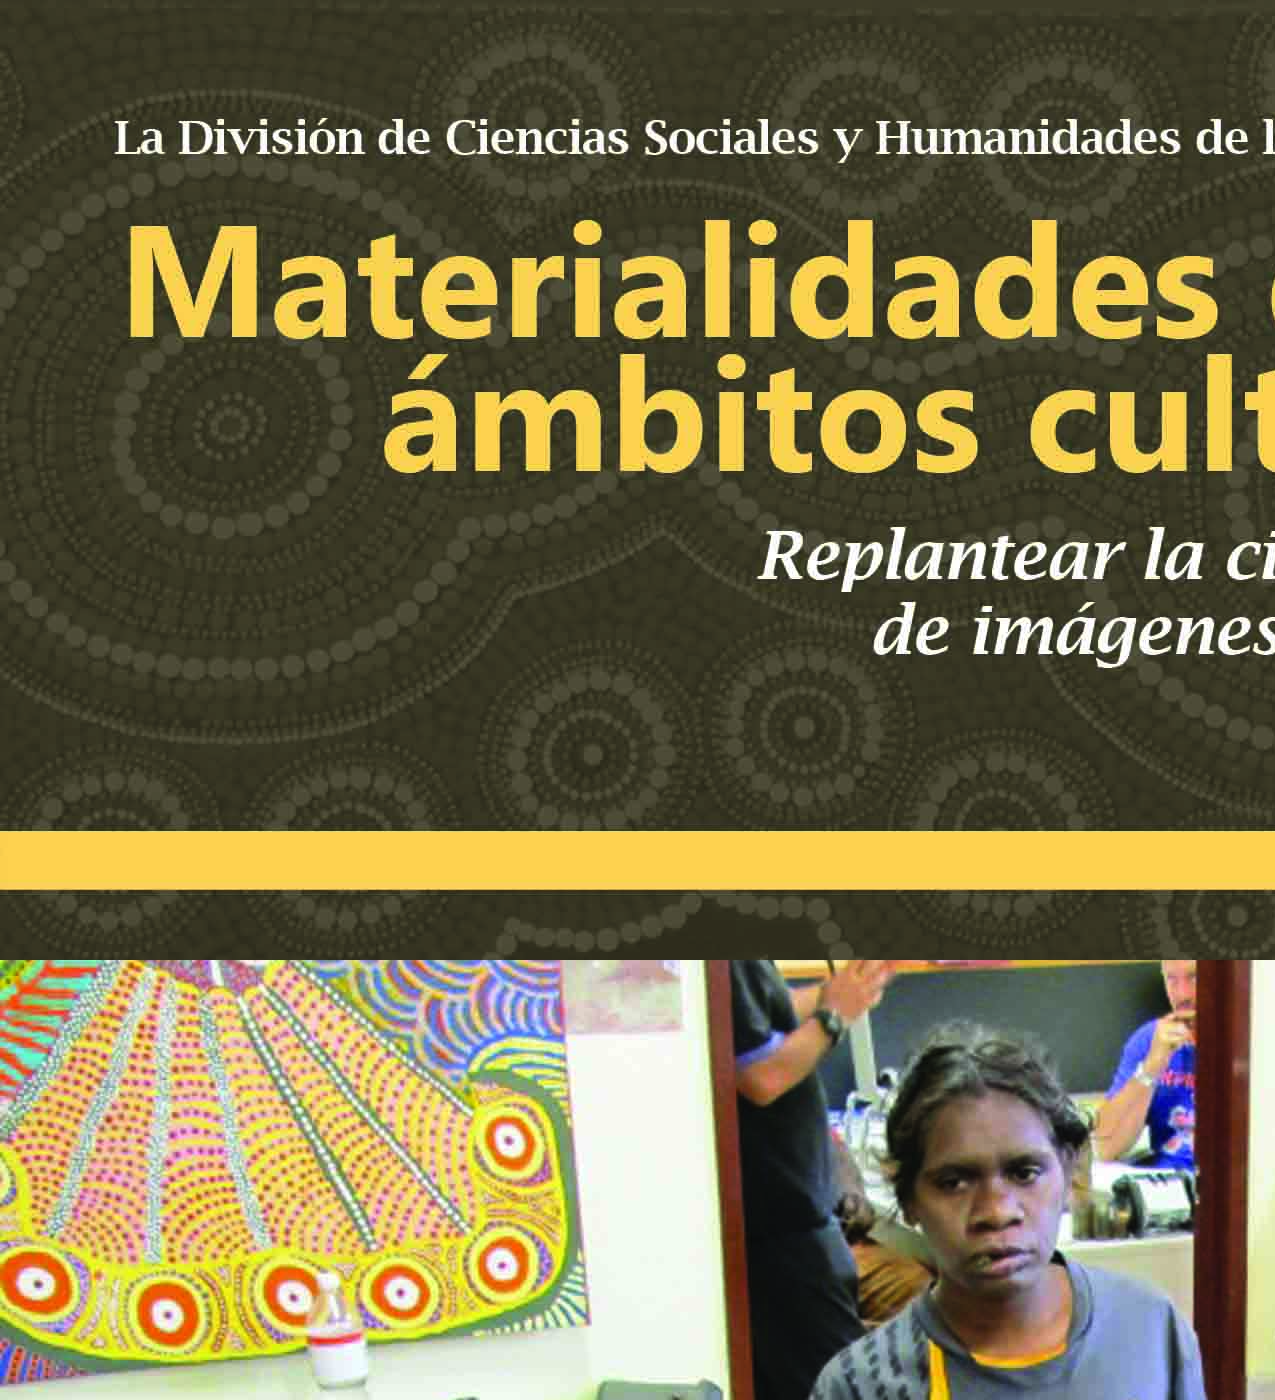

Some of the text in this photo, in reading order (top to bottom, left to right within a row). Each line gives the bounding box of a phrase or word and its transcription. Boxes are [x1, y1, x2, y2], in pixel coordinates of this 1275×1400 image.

[113, 119, 167, 156] La
[177, 116, 367, 156] División
[377, 117, 432, 156] de
[445, 117, 630, 157] Ciencias
[643, 117, 820, 157] Sociales
[831, 127, 865, 165] y
[874, 117, 1182, 156] Humanidades
[1195, 117, 1250, 156] de
[129, 218, 1219, 341] Materialidades
[382, 352, 979, 475] ámbitos
[756, 525, 1128, 594] Replantear
[1143, 525, 1205, 582] la
[872, 600, 951, 657] de
